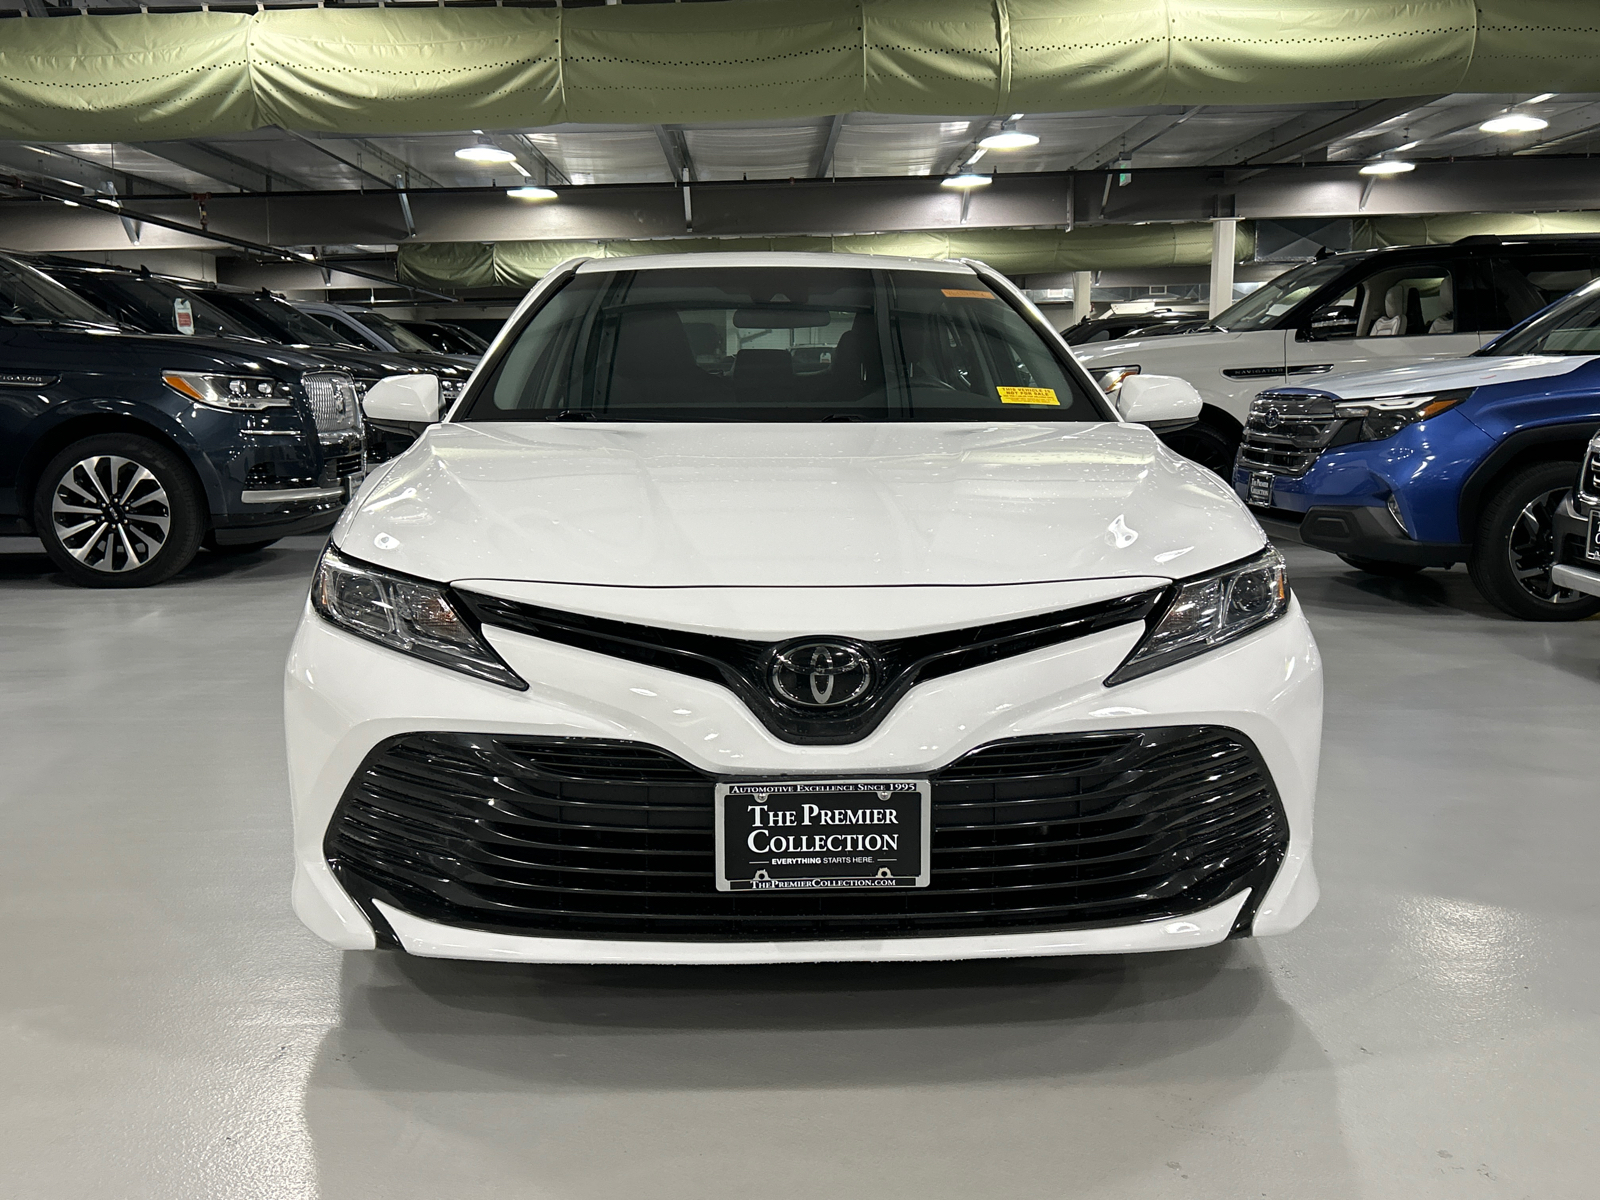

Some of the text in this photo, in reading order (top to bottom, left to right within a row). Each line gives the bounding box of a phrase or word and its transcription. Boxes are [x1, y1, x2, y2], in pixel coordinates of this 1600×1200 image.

[731, 783, 916, 794] AUTOMOTIVE EXCELLENCE SINCE 1995
[747, 804, 899, 827] THE PREMIER
[747, 829, 899, 853] COLLECTION
[772, 856, 875, 865] EVERYTHING STARTS HERE.
